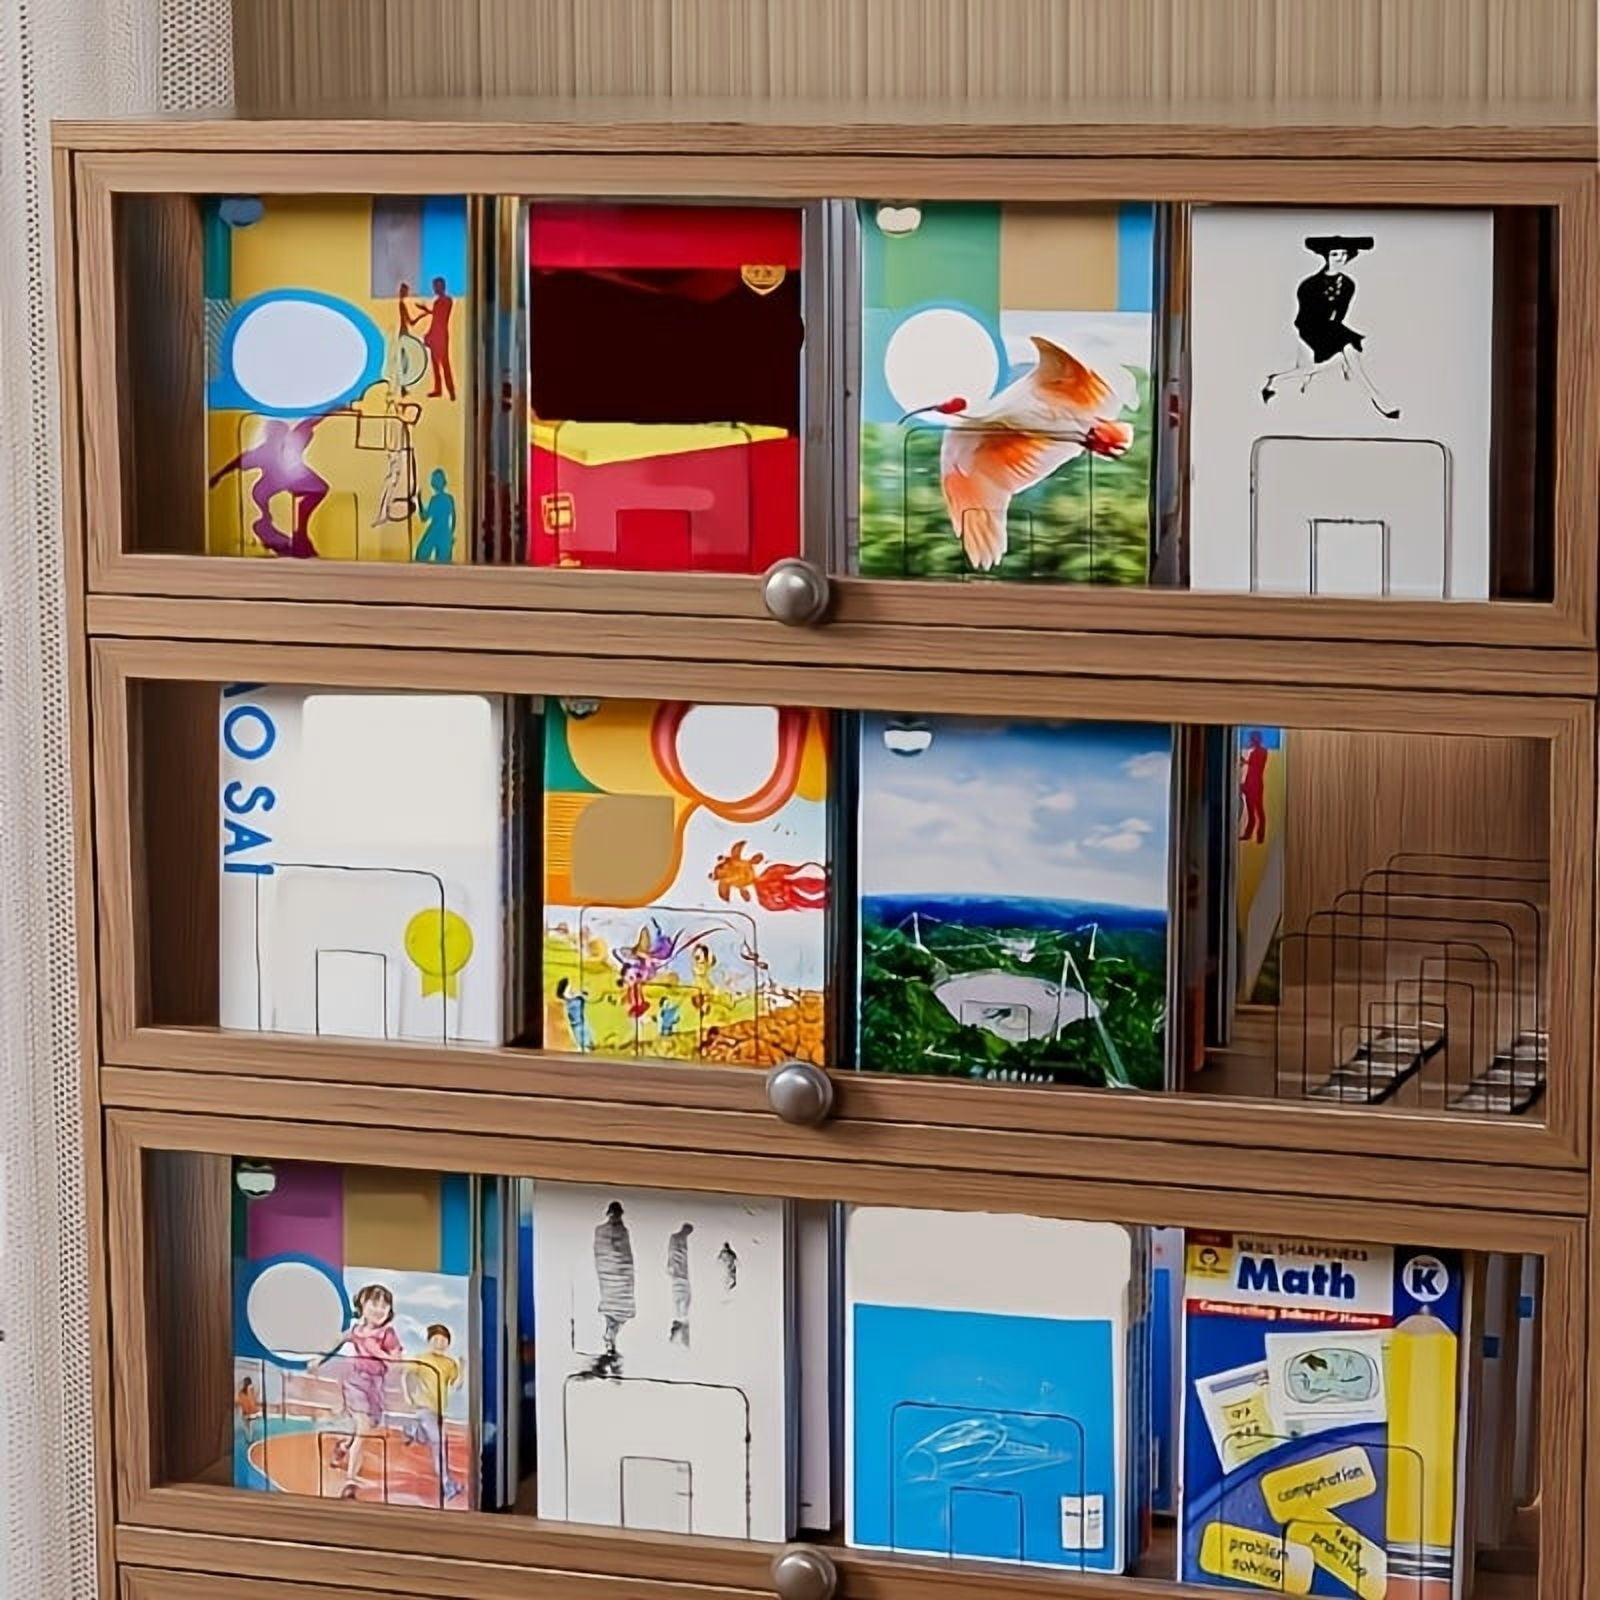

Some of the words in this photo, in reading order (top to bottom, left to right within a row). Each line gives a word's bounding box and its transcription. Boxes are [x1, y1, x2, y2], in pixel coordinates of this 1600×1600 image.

[224, 781, 276, 875] SAI
[1237, 1256, 1356, 1299] Math
[1412, 1268, 1441, 1295] K
[1277, 1465, 1364, 1502] computation
